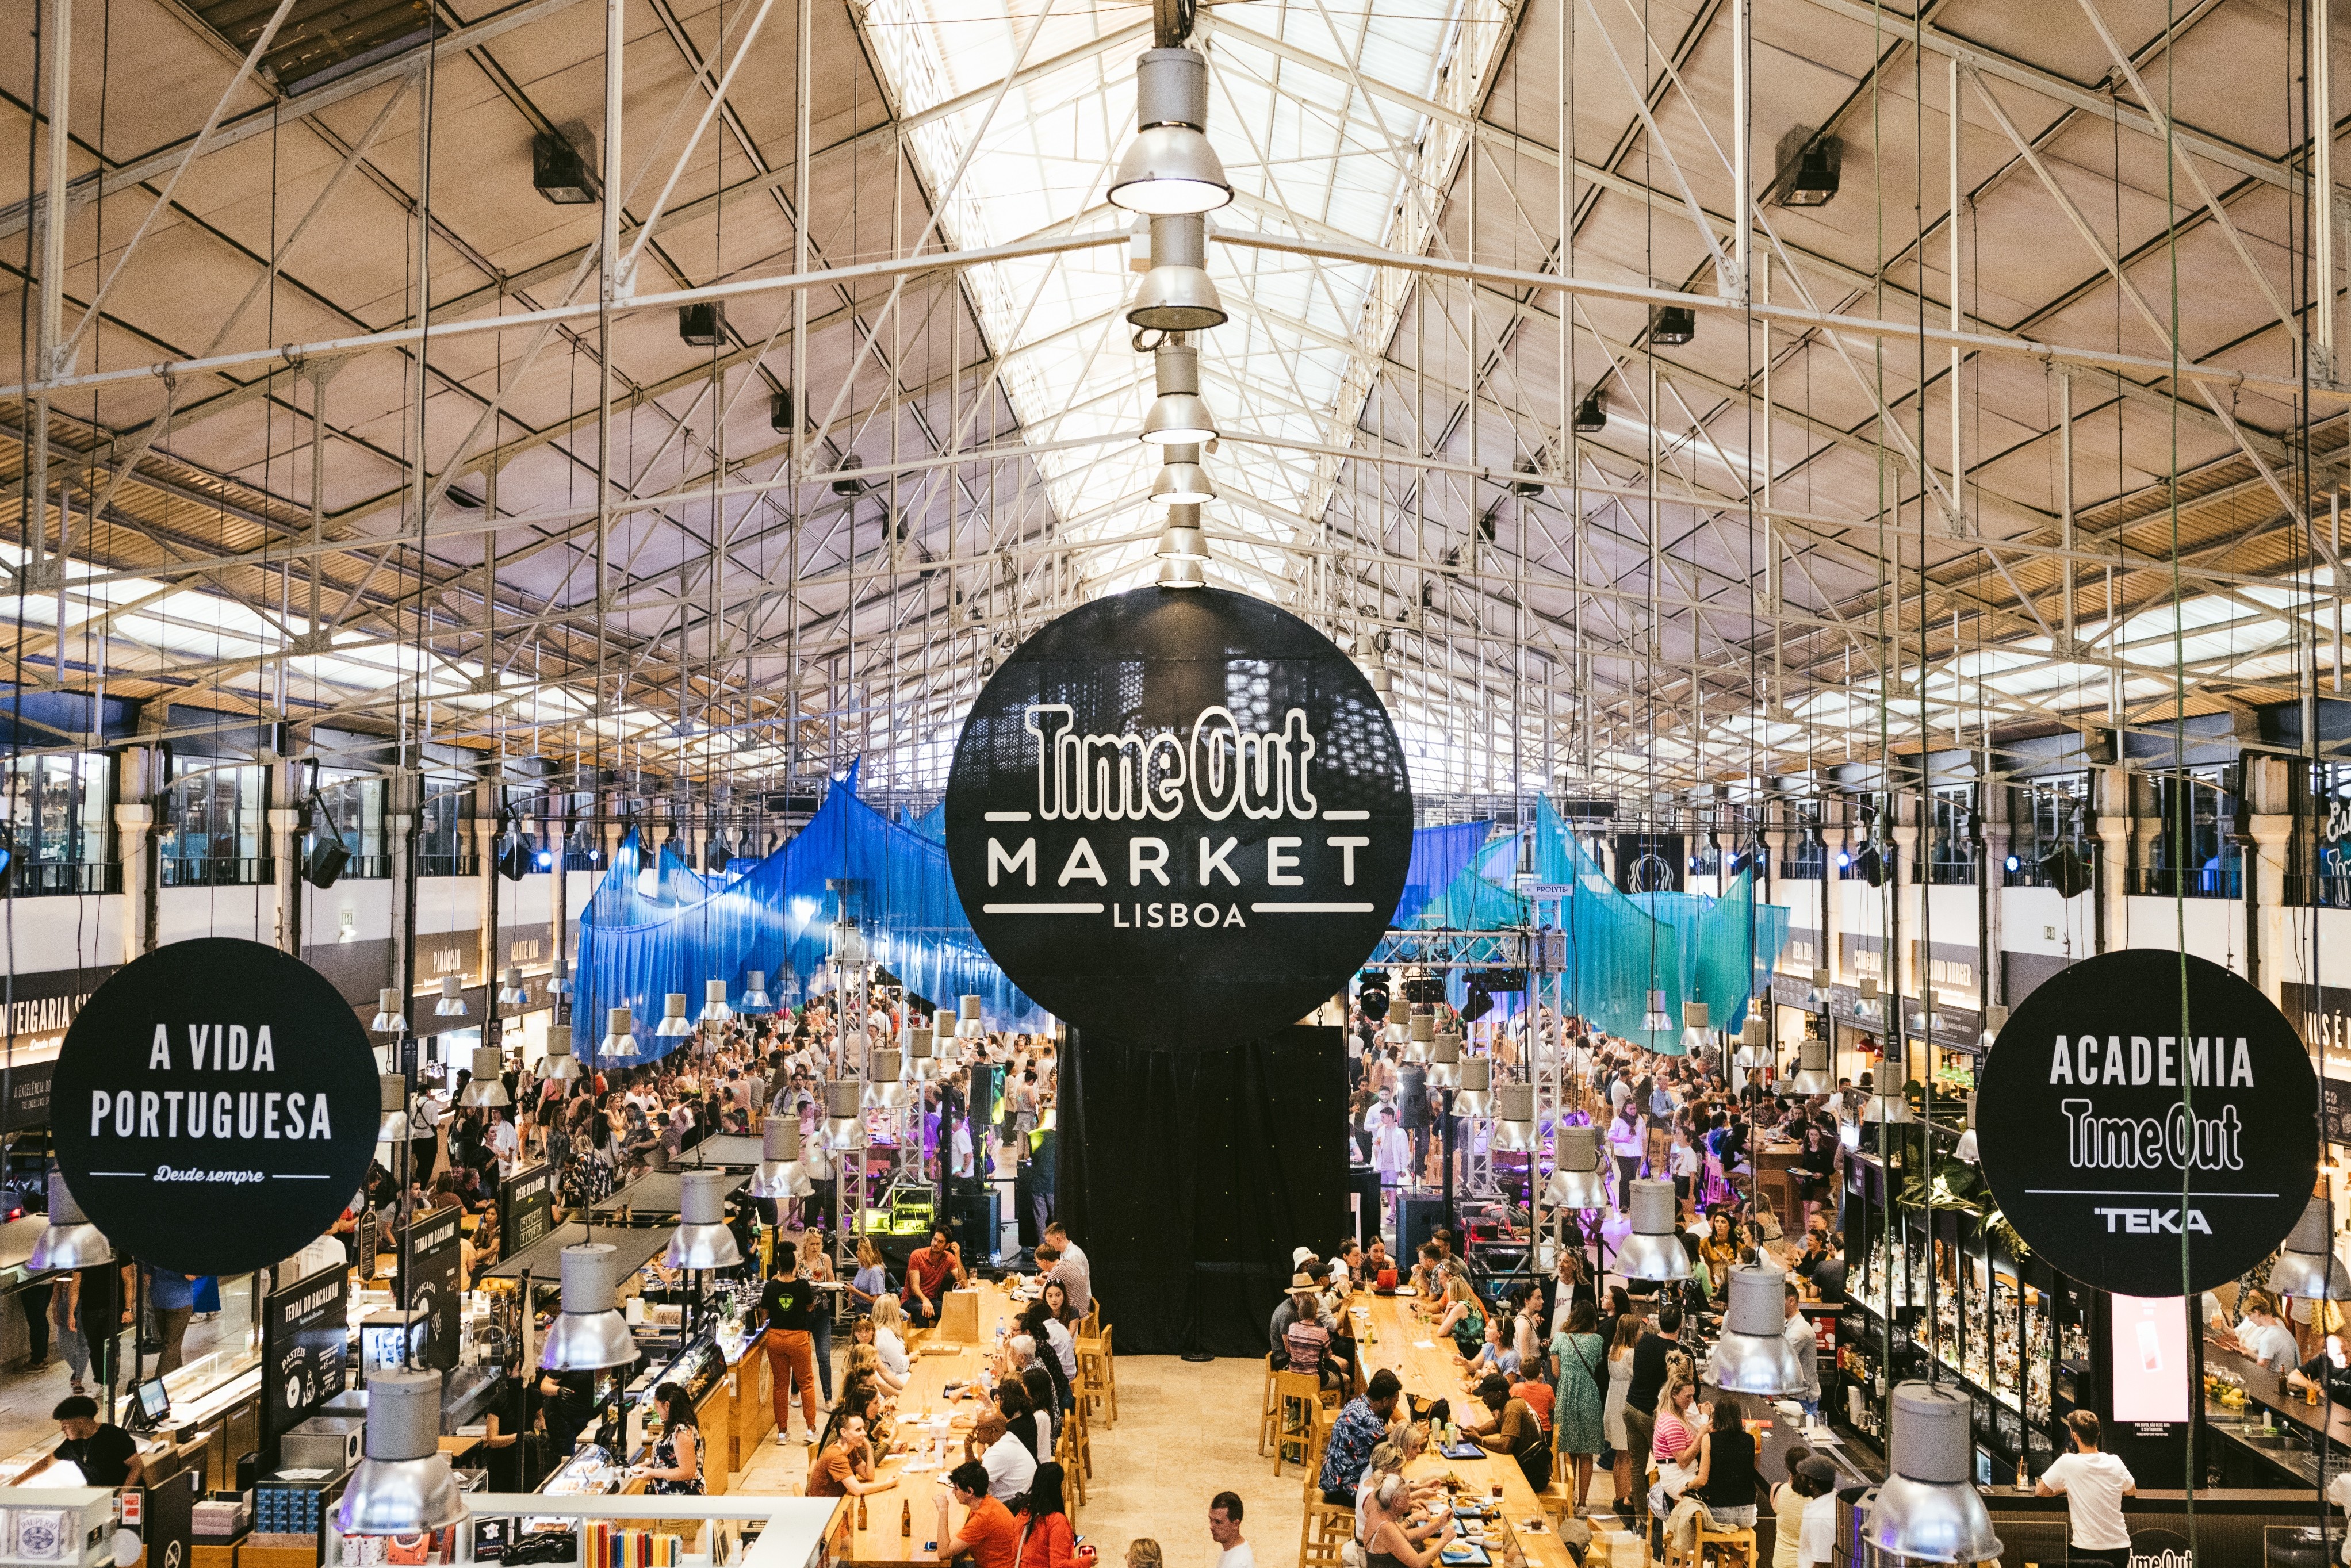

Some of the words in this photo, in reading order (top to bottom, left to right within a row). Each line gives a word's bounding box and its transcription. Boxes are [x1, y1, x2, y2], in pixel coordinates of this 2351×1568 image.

[1025, 704, 1186, 821] Time
[1190, 706, 1318, 821] Out
[987, 836, 1370, 887] MARKET
[1113, 903, 1246, 929] LISBOA
[1947, 961, 1972, 987] BURGER
[149, 1024, 171, 1071] A
[189, 1024, 275, 1072] VIDA
[2050, 1034, 2254, 1087] ACADEMIA
[91, 1090, 332, 1140] PORTUGUESA
[2061, 1098, 2163, 1170] Time
[2165, 1102, 2243, 1170] Out
[153, 1165, 205, 1182] Desde
[205, 1170, 265, 1186] sempre
[415, 1239, 427, 1255] TERRA
[428, 1233, 434, 1249] DO
[434, 1222, 454, 1245] BACALHAU
[2094, 1207, 2213, 1235] TEKA
[285, 1299, 303, 1323] TERRA
[303, 1295, 311, 1314] DO
[312, 1281, 339, 1309] BACALHAU
[282, 1346, 306, 1370] PASTÉIS
[2127, 1548, 2162, 1568] ime
